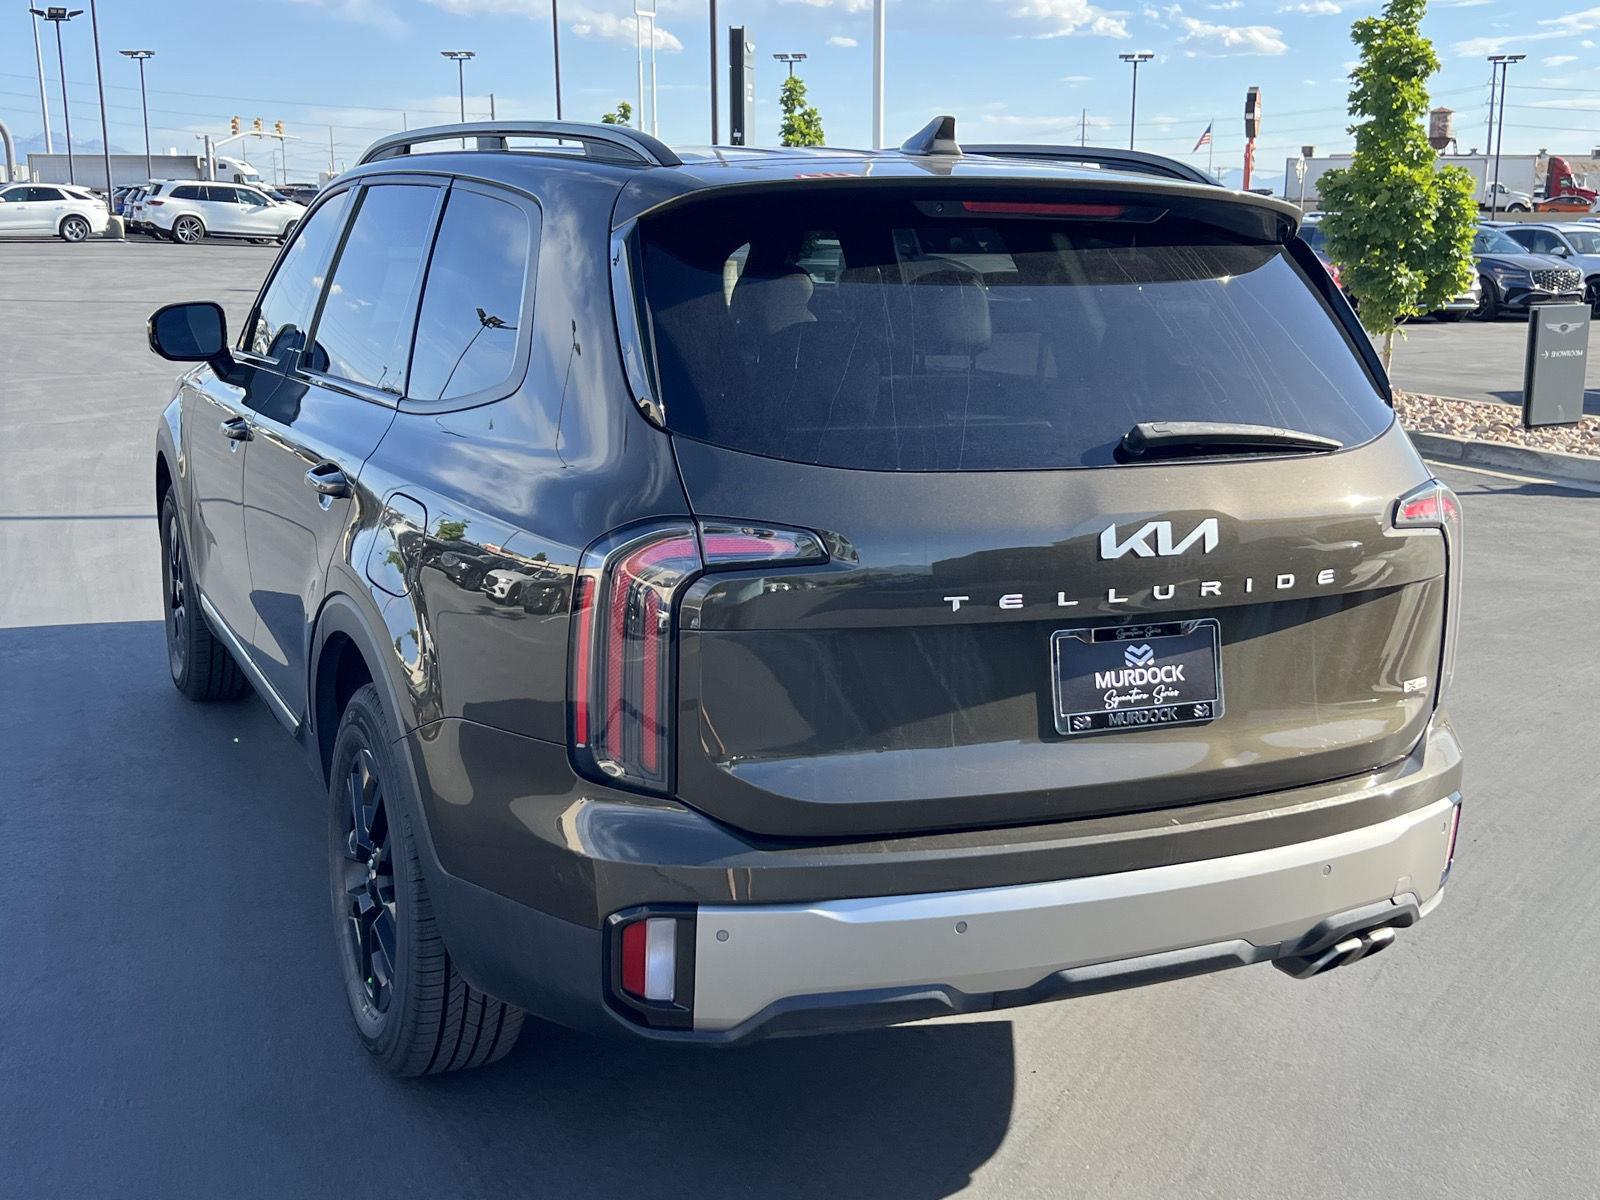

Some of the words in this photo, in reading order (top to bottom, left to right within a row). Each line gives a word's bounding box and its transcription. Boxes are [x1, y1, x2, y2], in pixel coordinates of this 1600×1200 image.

[1100, 517, 1219, 559] KIA
[943, 569, 1335, 612] TELLURIDE
[1095, 664, 1185, 689] MURDOCK
[1104, 687, 1149, 710] Signature
[1153, 685, 1179, 704] Series
[1108, 707, 1178, 726] MURDOCK
